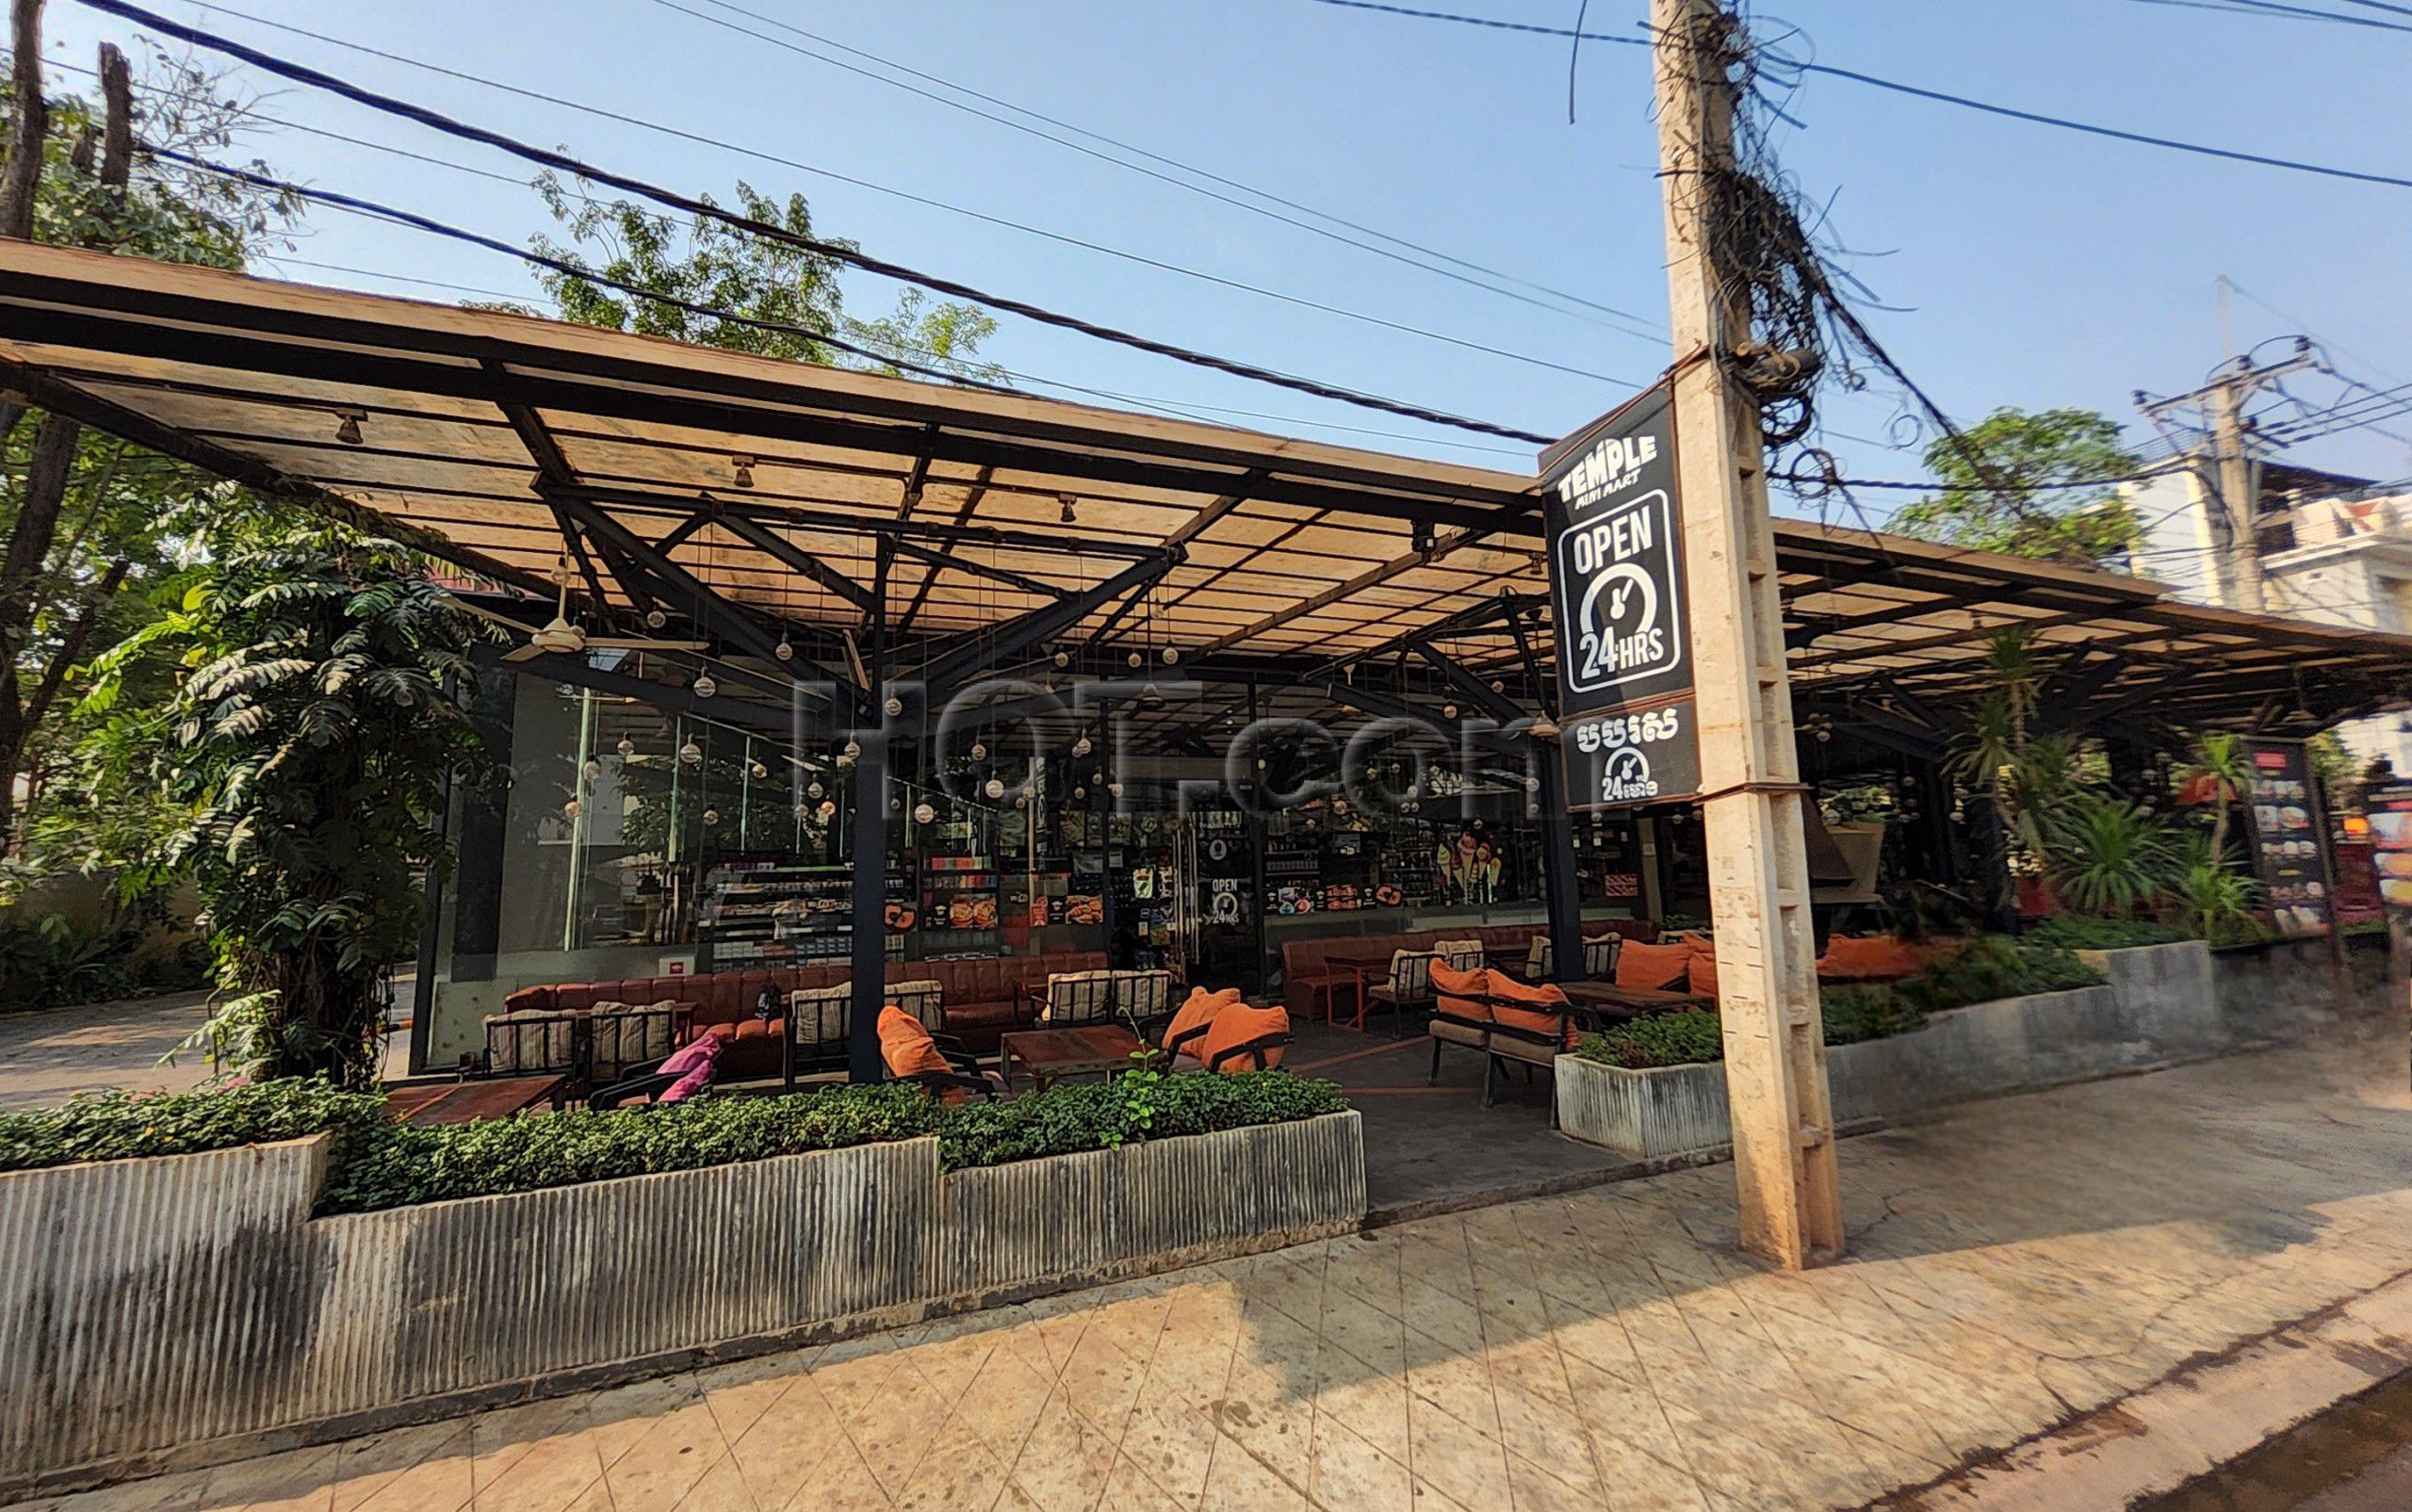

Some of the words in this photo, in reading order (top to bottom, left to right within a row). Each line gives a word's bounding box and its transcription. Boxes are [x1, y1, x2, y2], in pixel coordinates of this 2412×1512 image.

[1557, 435, 1657, 503] TEMPLE
[1603, 468, 1641, 497] MART
[1573, 505, 1654, 575] OPEN
[1212, 879, 1238, 892] OPEN
